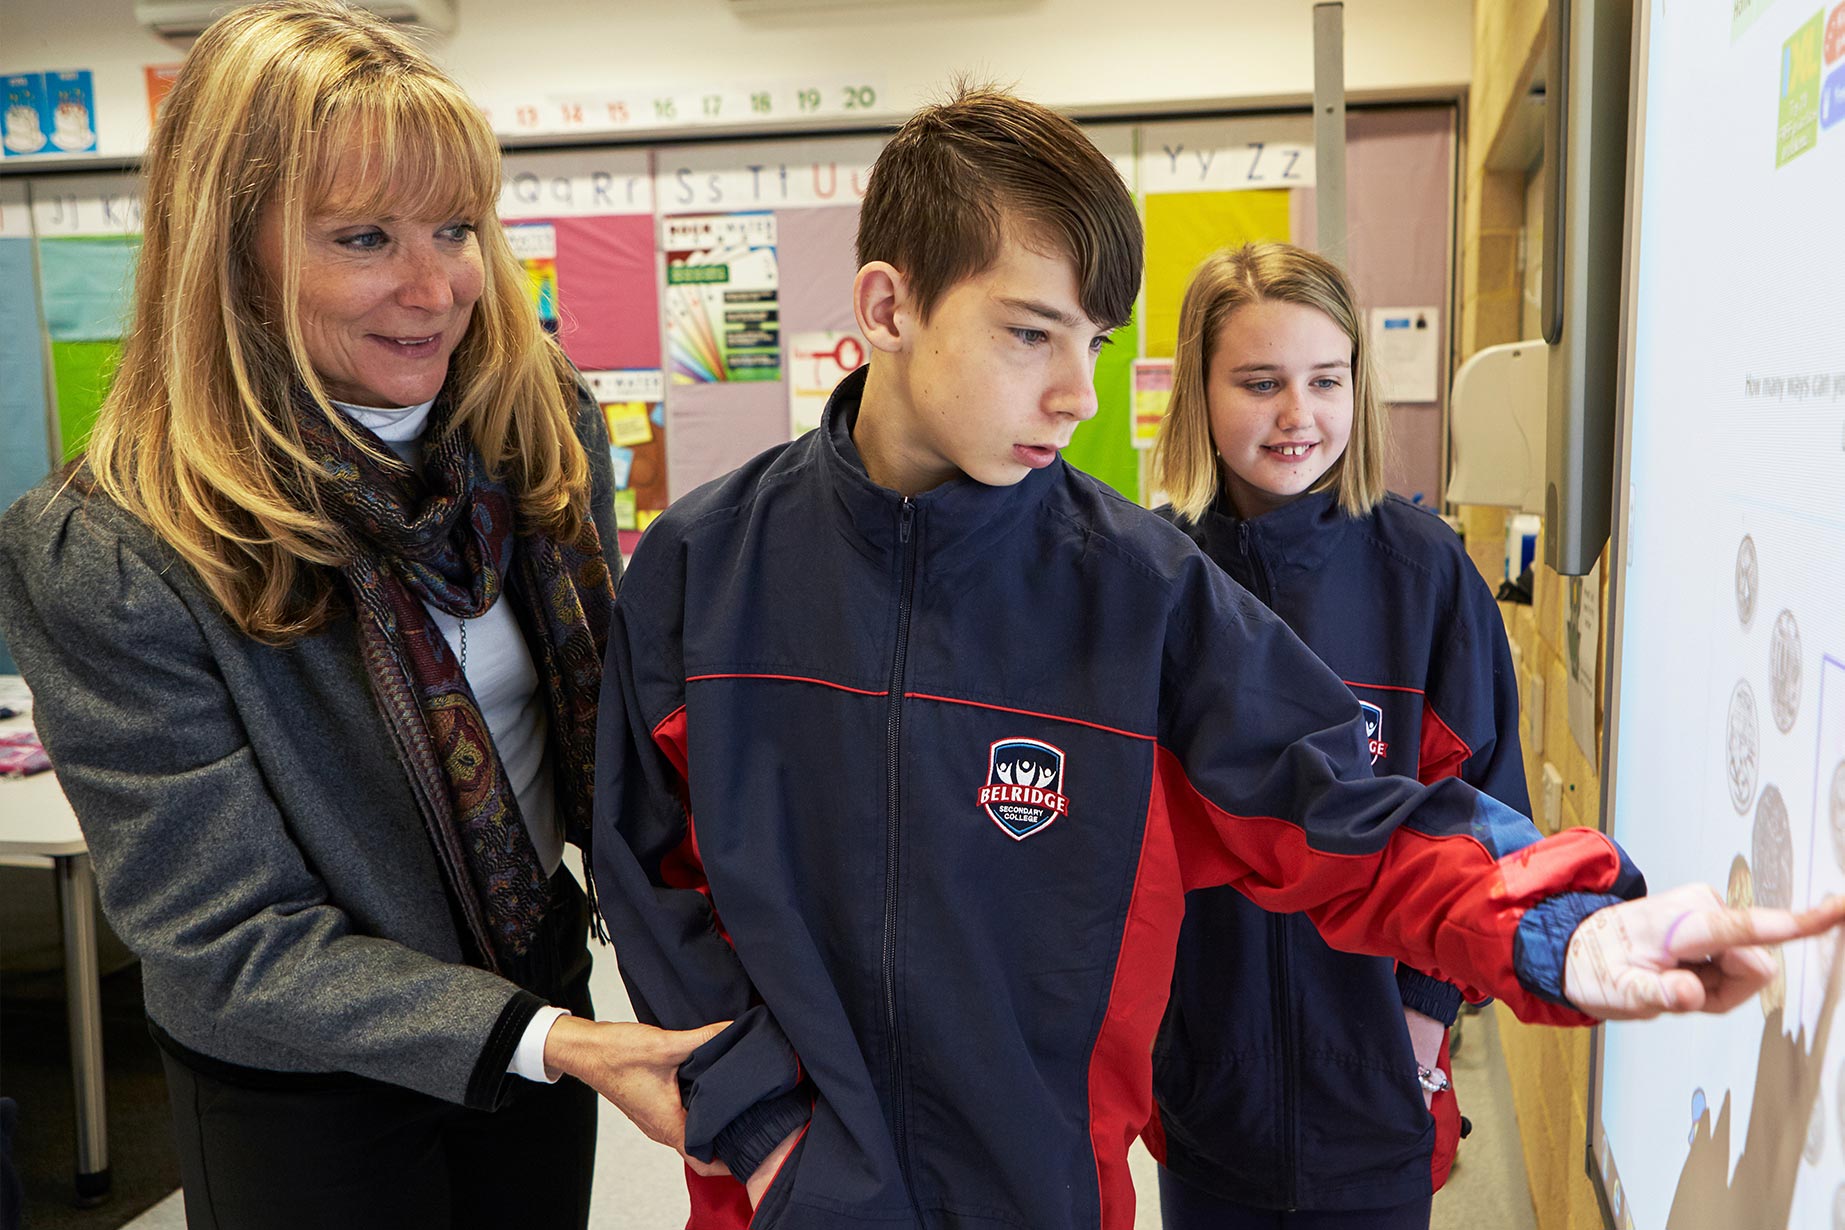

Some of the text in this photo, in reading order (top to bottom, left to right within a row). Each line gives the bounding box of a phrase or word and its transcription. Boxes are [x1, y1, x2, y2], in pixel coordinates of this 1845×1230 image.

[515, 104, 539, 127] 13
[607, 101, 630, 123] 15
[653, 98, 677, 119] 16
[702, 95, 722, 117] 17
[750, 90, 773, 113] 18
[797, 86, 822, 111] 19
[843, 85, 877, 109] 20
[980, 786, 1065, 813] BELRIDGE
[999, 805, 1044, 817] SECONDARY
[1004, 814, 1038, 823] COLLEGE
